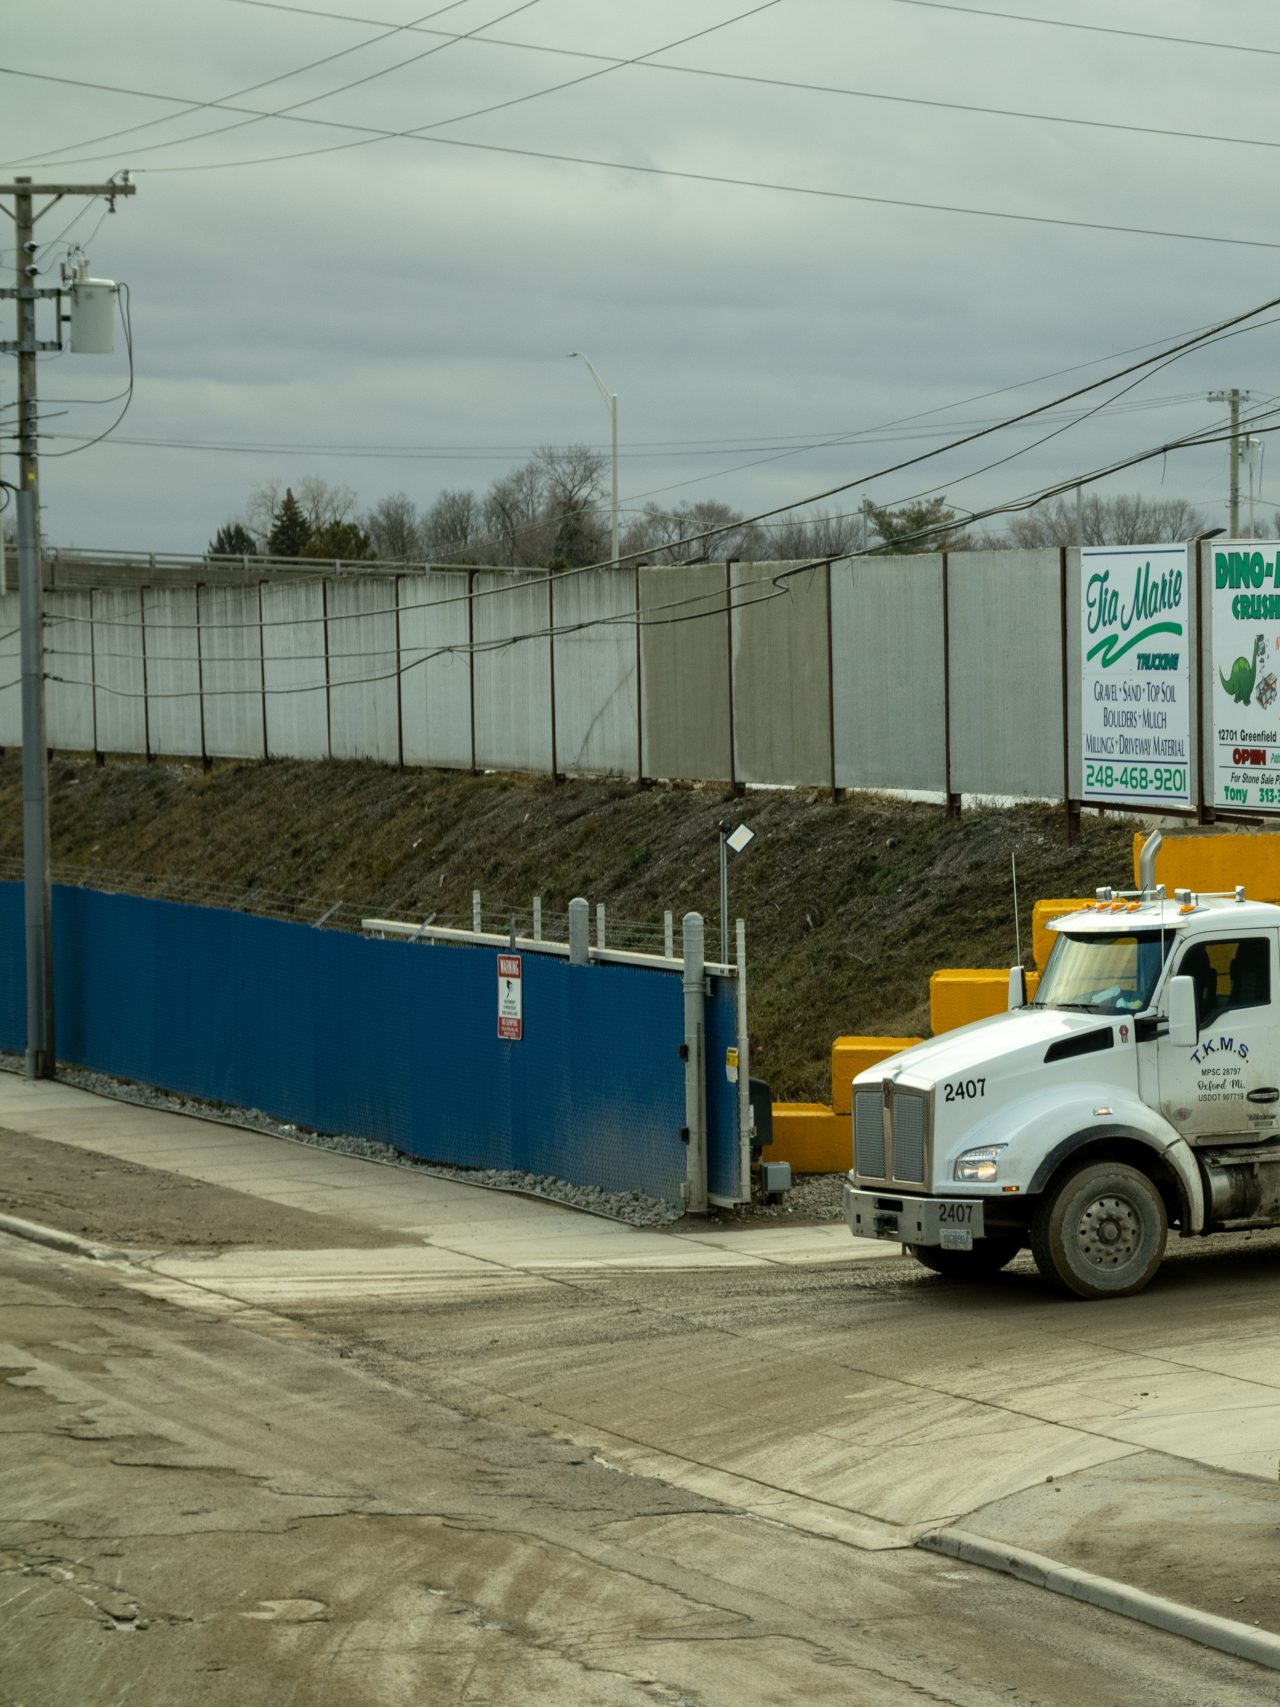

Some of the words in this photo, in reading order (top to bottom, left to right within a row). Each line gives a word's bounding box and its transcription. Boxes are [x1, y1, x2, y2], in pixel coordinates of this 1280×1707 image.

[1087, 569, 1119, 634] Tia
[1121, 561, 1182, 631] Marie
[1137, 653, 1180, 670] TRUCKING
[1094, 680, 1118, 702] GRAVEL
[1123, 681, 1141, 702] SAND
[1146, 681, 1160, 702] TOP
[1161, 681, 1176, 702] SOIL
[1103, 707, 1137, 728] BOULDERS
[1142, 708, 1167, 729] MULCH
[1086, 734, 1114, 754] MILLINGS
[1119, 734, 1151, 756] DRIVEWAY
[1153, 736, 1185, 757] MATERIAL
[1218, 729, 1237, 741] 12701
[1240, 729, 1277, 743] Greenfield
[1233, 748, 1266, 765] OPEN
[1086, 764, 1186, 792] 248-468-9201
[1231, 772, 1241, 783] For
[1242, 772, 1259, 784] Stone
[1261, 773, 1274, 785] Sale
[1224, 785, 1248, 804] Tony
[1202, 1068, 1221, 1076] MPSC
[1222, 1067, 1241, 1076] 28797
[944, 1077, 986, 1102] 2407
[1197, 1078, 1227, 1091] Oxford
[1198, 1093, 1221, 1101] USDOT
[939, 1203, 973, 1223] 2407
